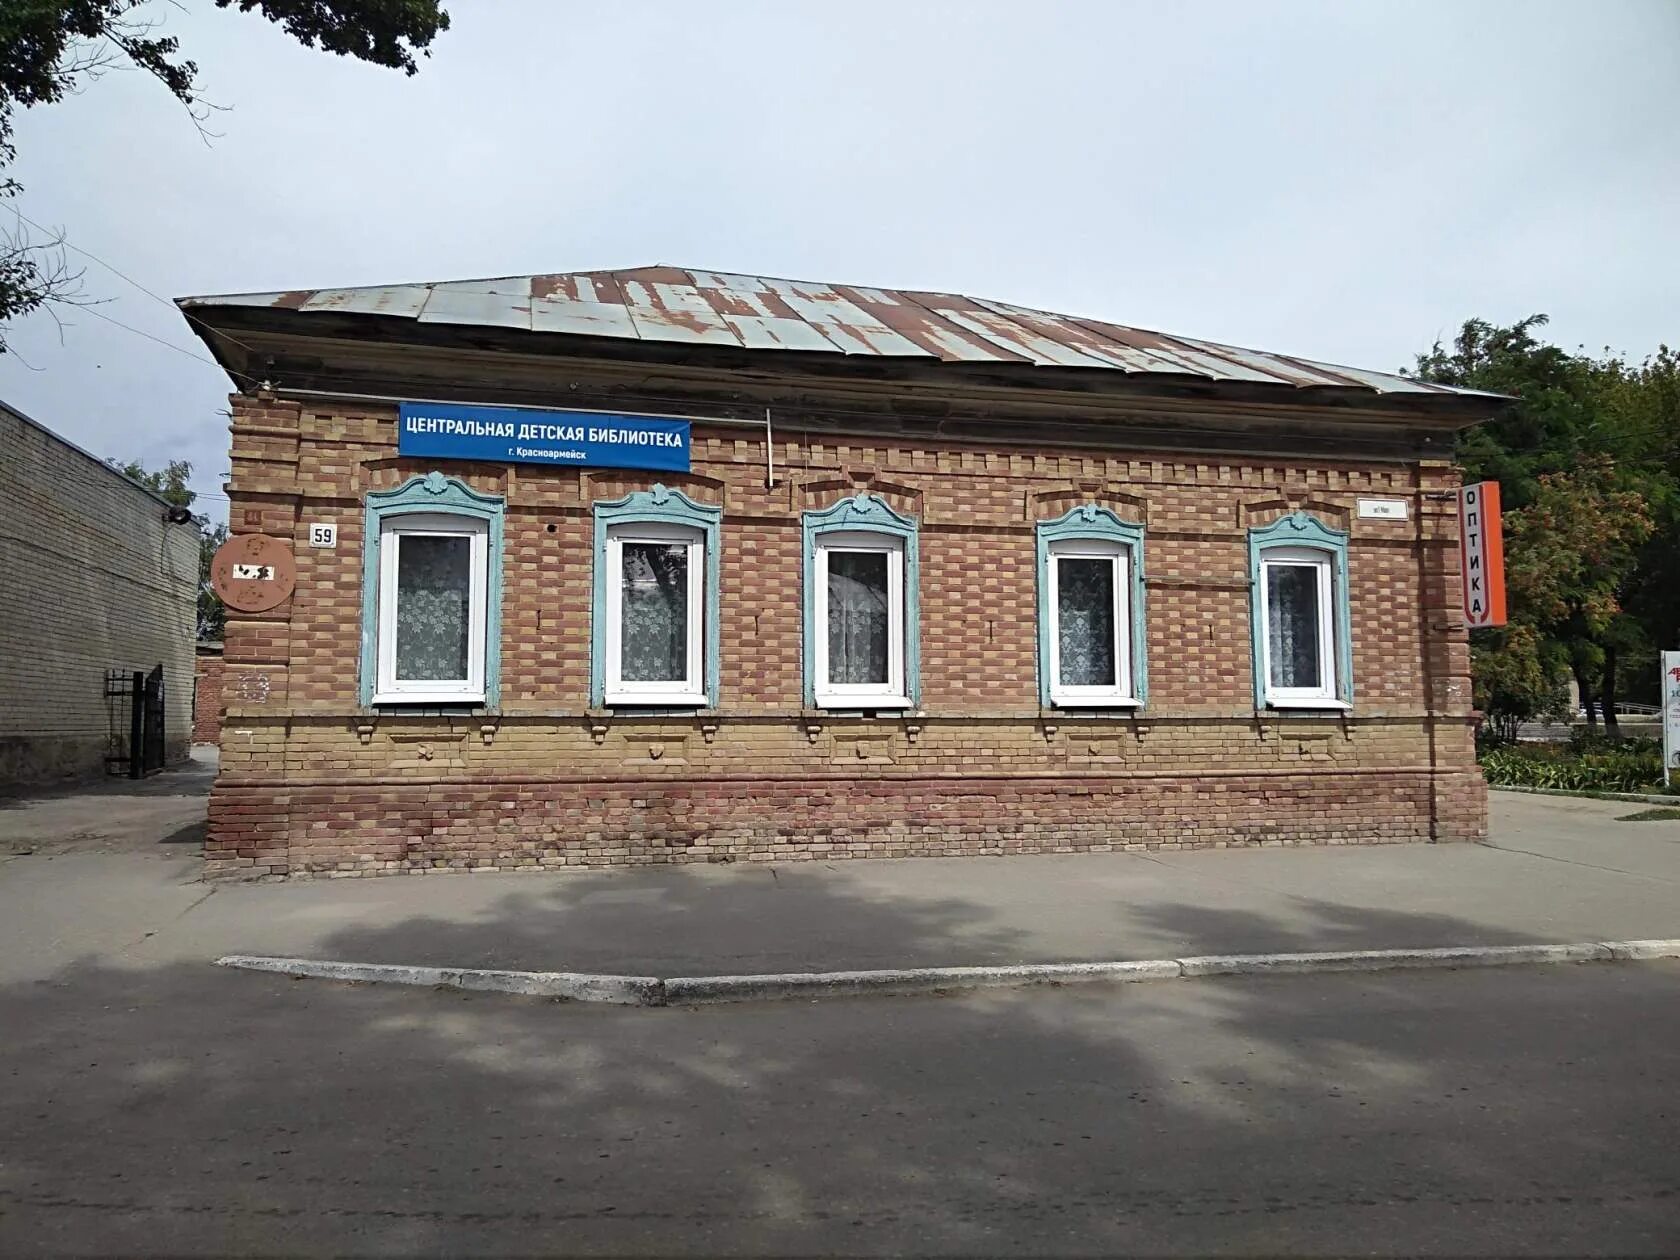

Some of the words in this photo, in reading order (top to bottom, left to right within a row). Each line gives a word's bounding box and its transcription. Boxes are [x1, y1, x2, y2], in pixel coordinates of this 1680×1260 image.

[406, 416, 514, 437] ЦЕНТРАЛЬНАЯ
[518, 423, 585, 442] ДЕТСКАЯ
[588, 428, 683, 448] БИБЛИОТЕКА
[516, 447, 586, 460] Красноармейск
[314, 528, 332, 543] 59
[1466, 491, 1482, 613] ОПТИКА
